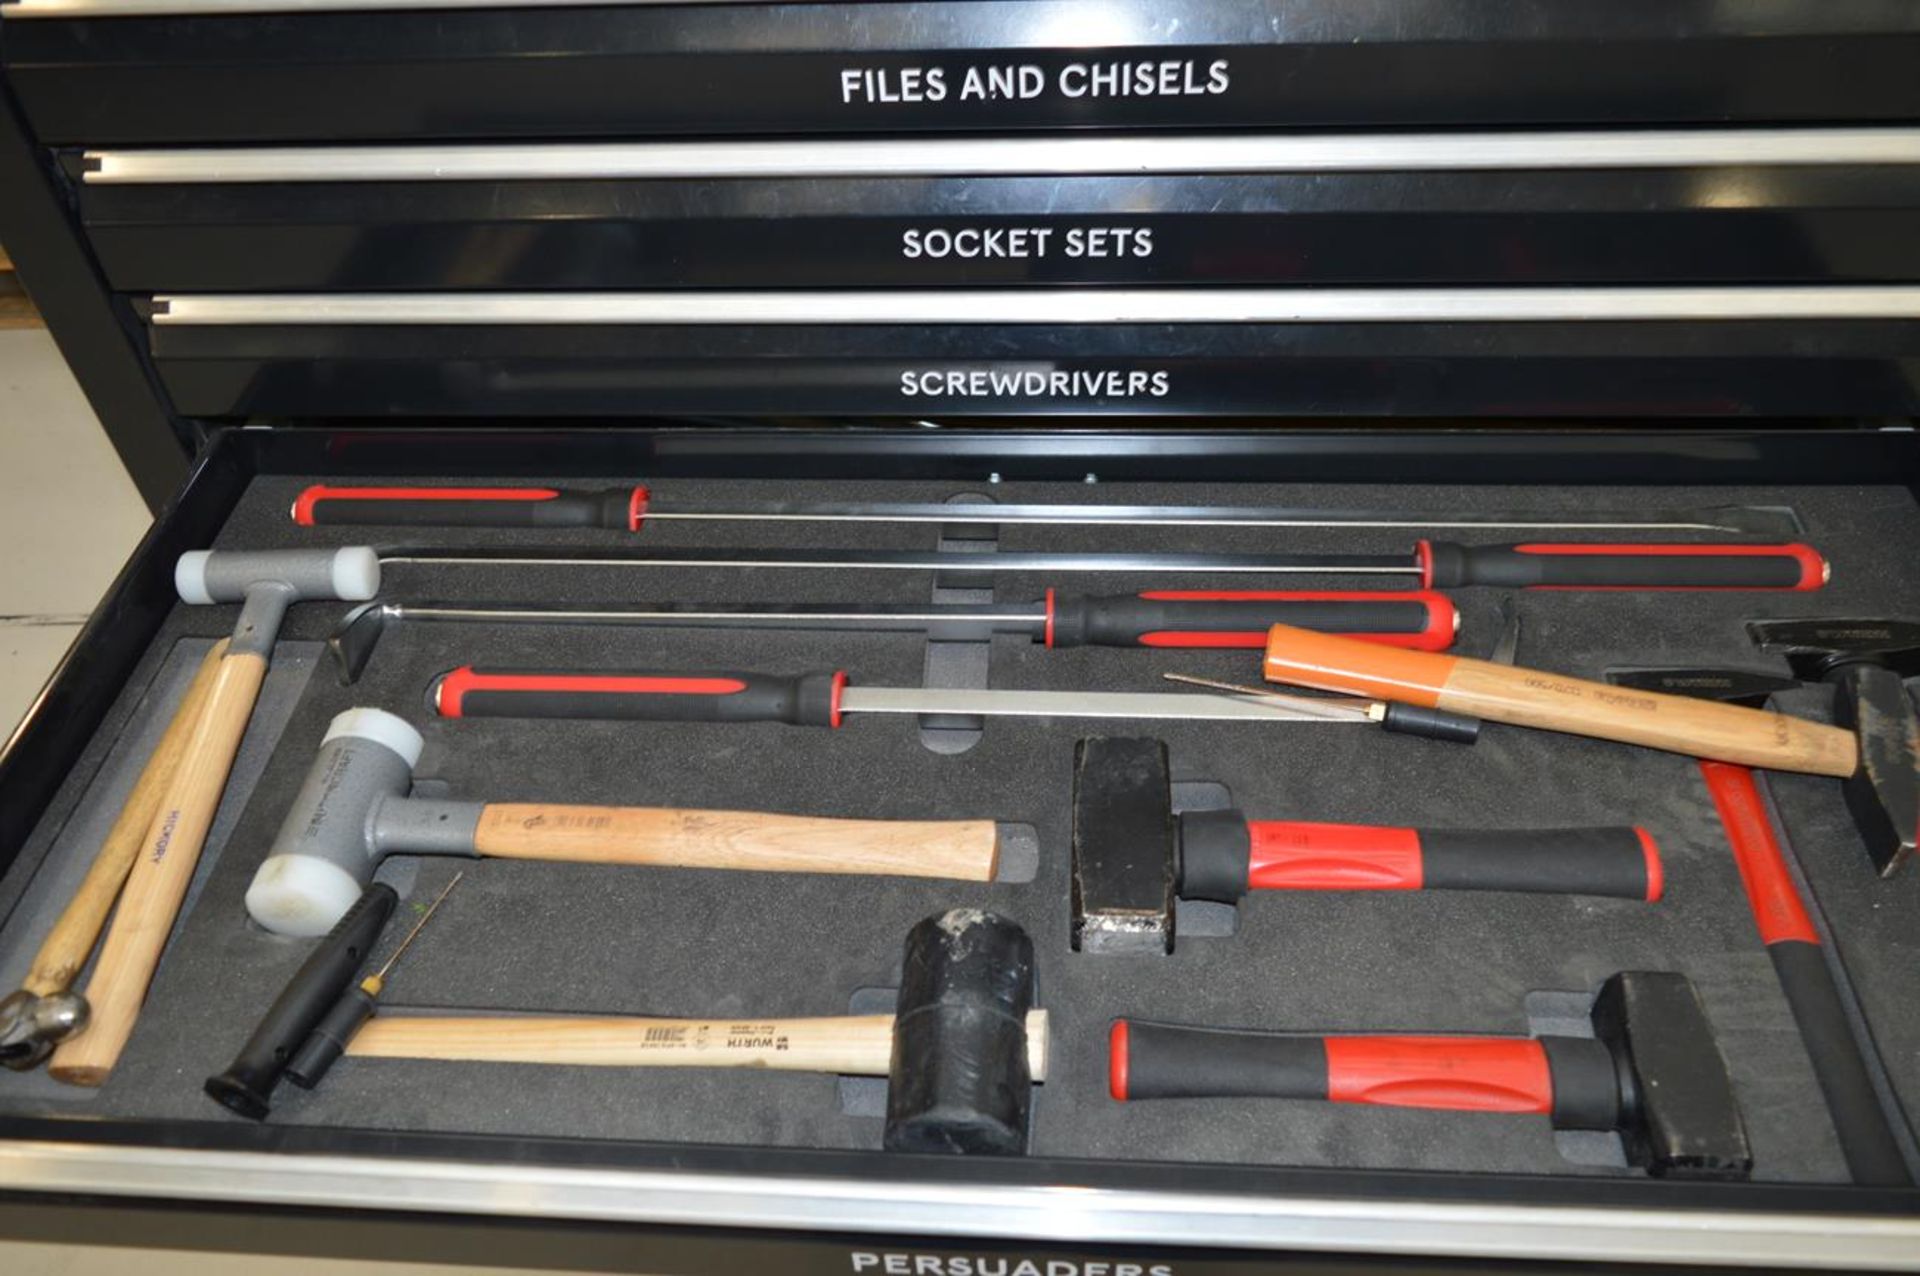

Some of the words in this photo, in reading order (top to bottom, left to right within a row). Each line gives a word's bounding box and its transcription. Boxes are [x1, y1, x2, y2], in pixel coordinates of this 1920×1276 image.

[840, 67, 947, 103] FILES
[959, 65, 1045, 101] AND
[1059, 60, 1229, 98] CHISELS
[903, 228, 1053, 258] SOCKET
[1064, 228, 1153, 258] SETS
[900, 370, 1169, 397] SCREWDRIVERS
[152, 810, 181, 864] HICKORY
[851, 1252, 1171, 1276] PERSUADERS
